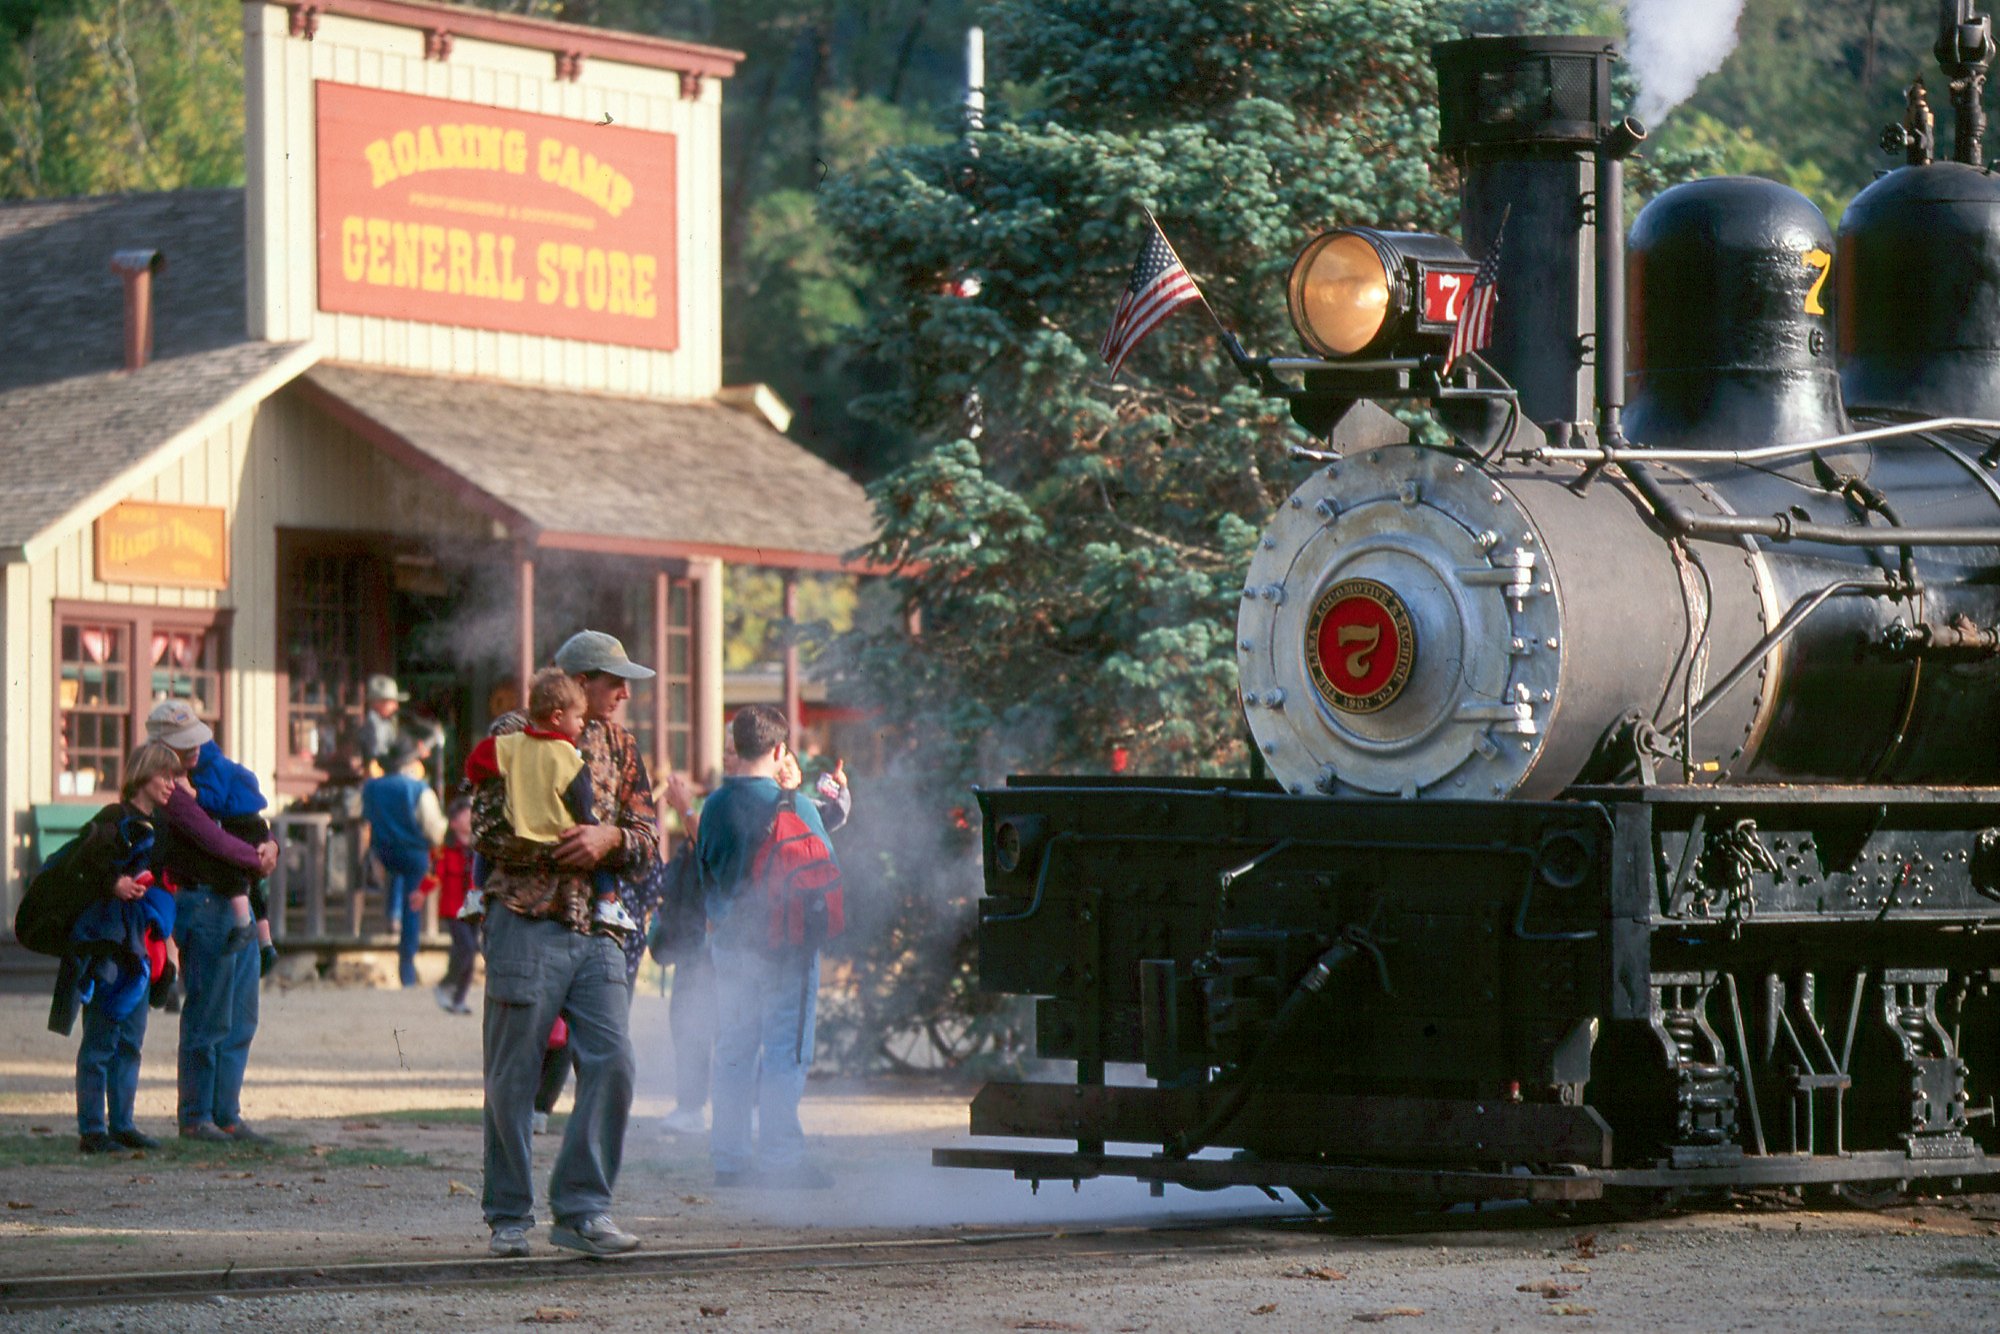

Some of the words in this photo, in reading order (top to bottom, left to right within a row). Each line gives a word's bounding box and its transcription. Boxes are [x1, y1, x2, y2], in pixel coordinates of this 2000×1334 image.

[364, 124, 527, 189] ROARING
[538, 137, 634, 218] CAMP
[342, 215, 525, 302] GENERAL
[536, 242, 657, 319] STORE
[1802, 249, 1831, 315] 7
[1439, 273, 1461, 321] 7
[1316, 583, 1390, 617] LOCOMOTIVE
[1307, 629, 1319, 668] LIMA
[1338, 623, 1380, 678] 7
[1393, 616, 1410, 681] MACHINE
[1318, 675, 1337, 702] THE
